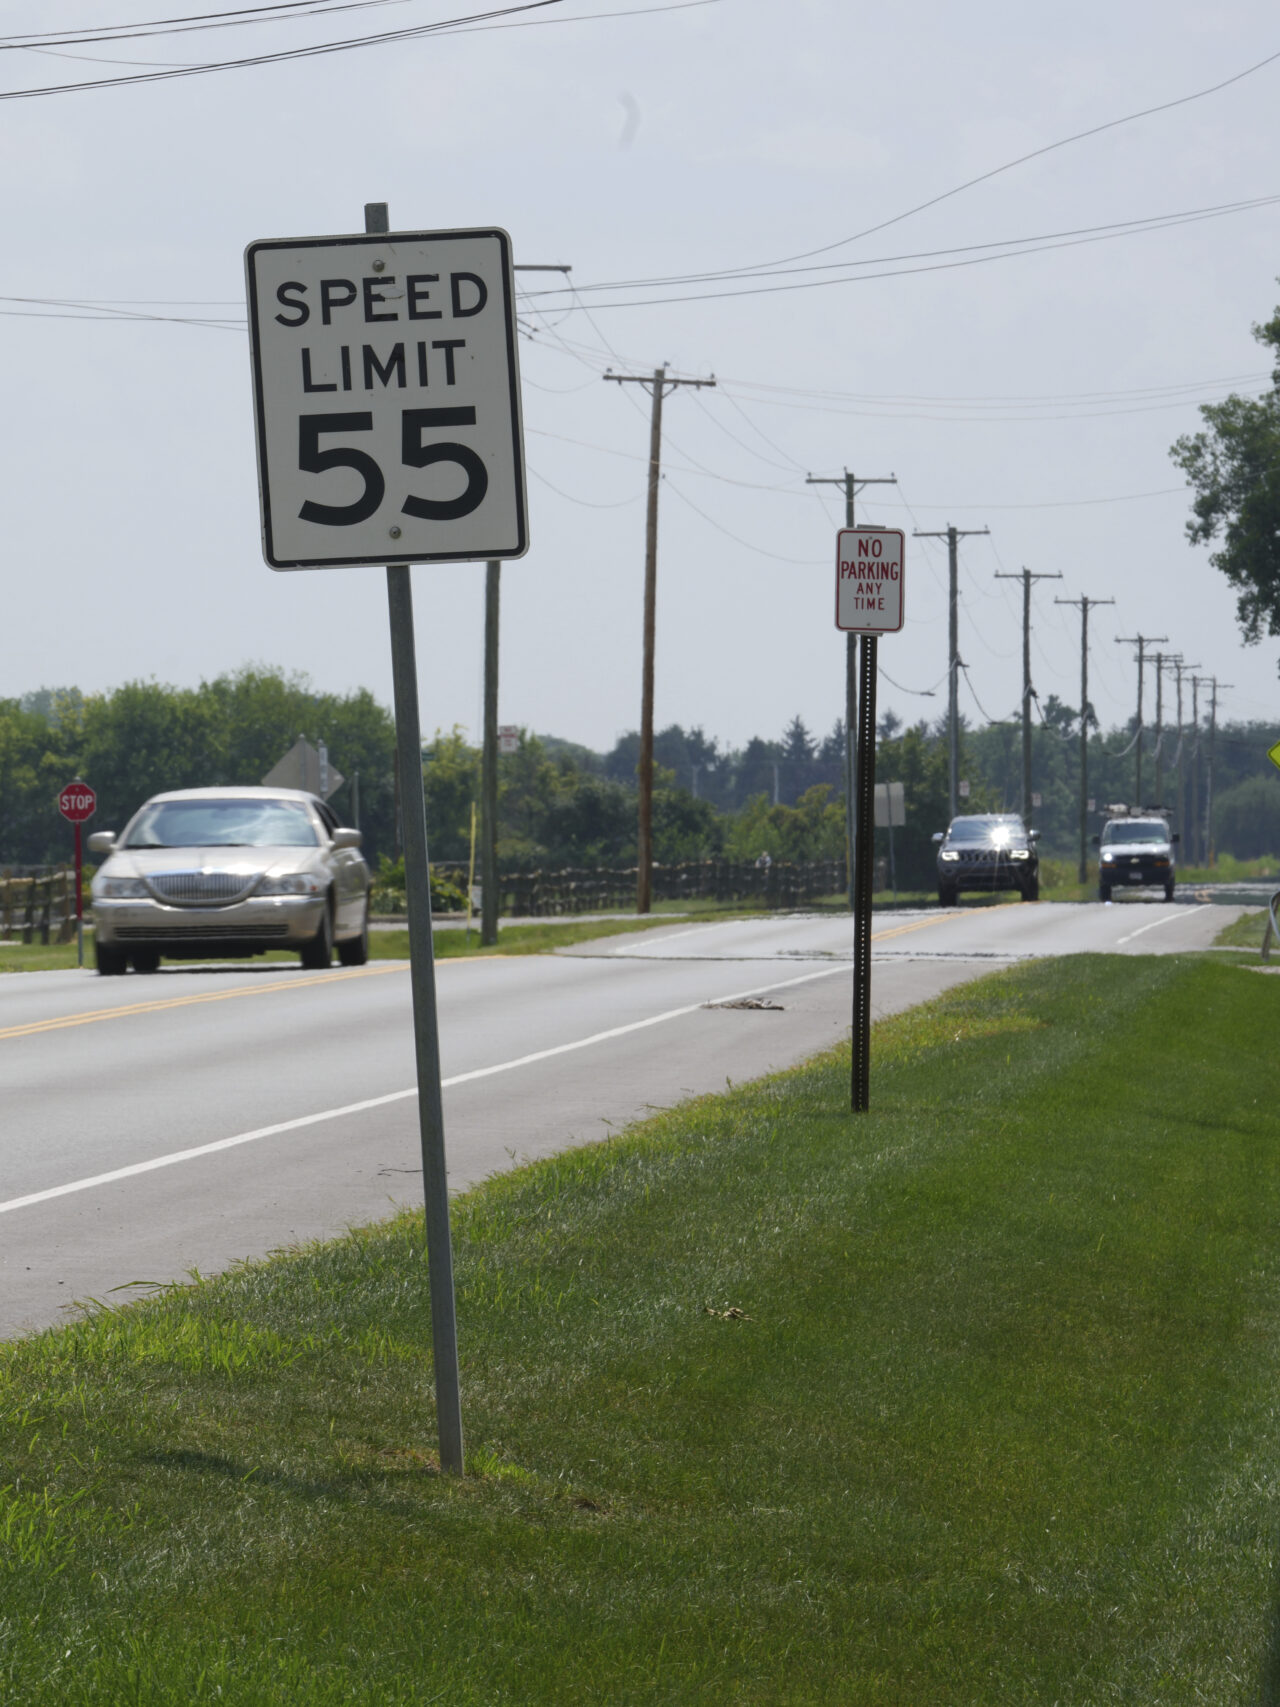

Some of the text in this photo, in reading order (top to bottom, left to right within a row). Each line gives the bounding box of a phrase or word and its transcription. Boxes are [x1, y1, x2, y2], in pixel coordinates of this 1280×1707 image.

[274, 272, 488, 327] SPEED
[301, 339, 466, 393] LIMIT
[297, 405, 489, 526] 55
[858, 538, 883, 558] NO
[841, 560, 899, 581] PARKING
[856, 582, 882, 595] ANY
[853, 597, 885, 611] TIME
[62, 795, 93, 810] STOP
